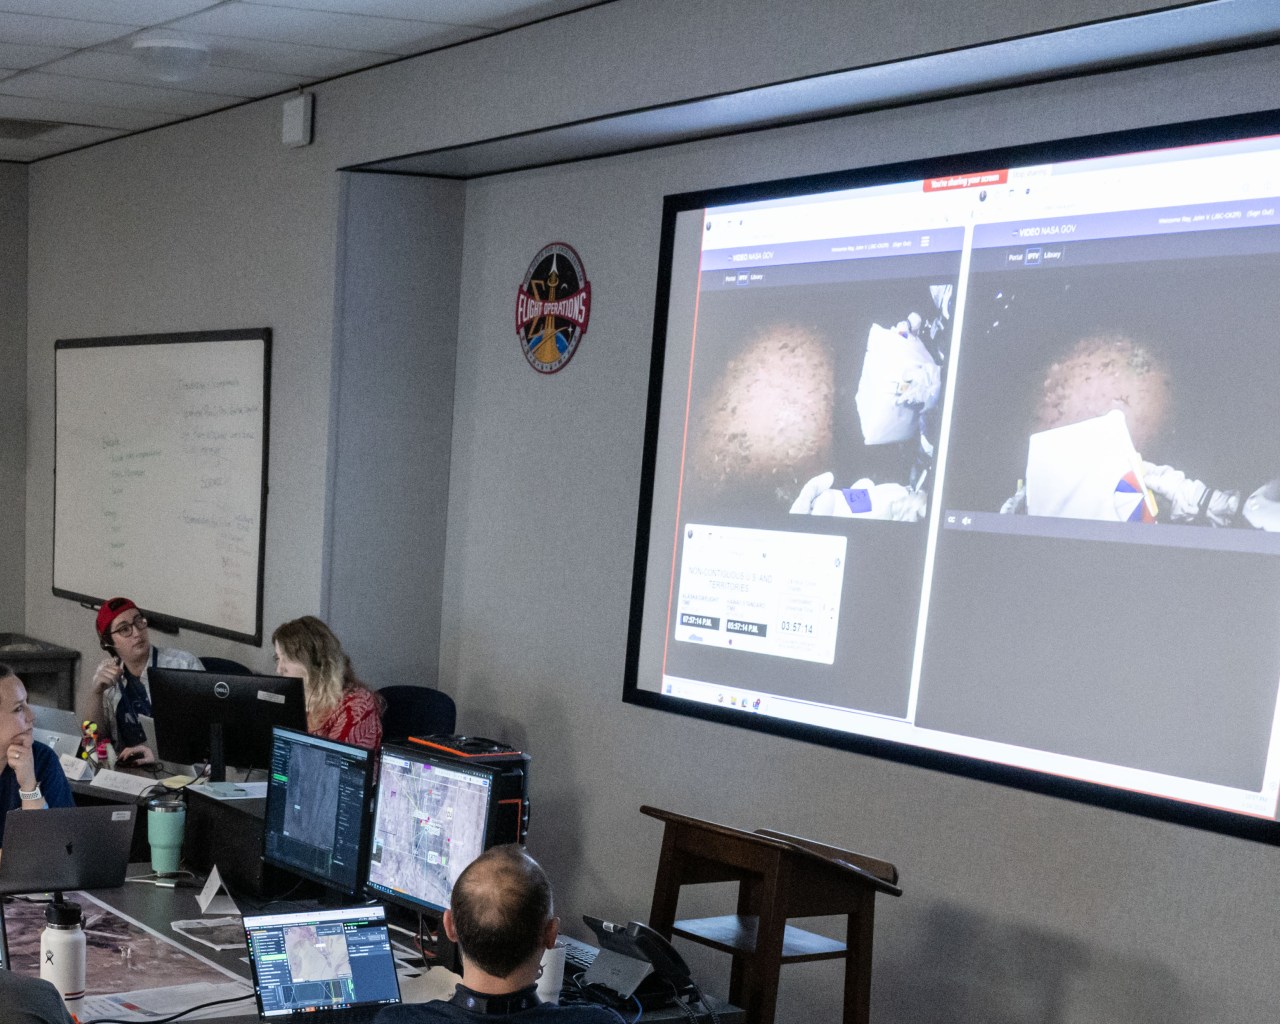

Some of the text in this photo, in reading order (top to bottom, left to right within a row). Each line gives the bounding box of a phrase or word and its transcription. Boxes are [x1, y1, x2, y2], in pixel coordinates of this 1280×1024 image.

[931, 173, 999, 188] You're sharing your screen
[1019, 224, 1077, 237] VIDEO NASA GOV
[517, 292, 587, 325] FLIGHT OPERATIONS
[709, 580, 749, 592] TERRITORIES
[781, 621, 813, 634] 03:57:14
